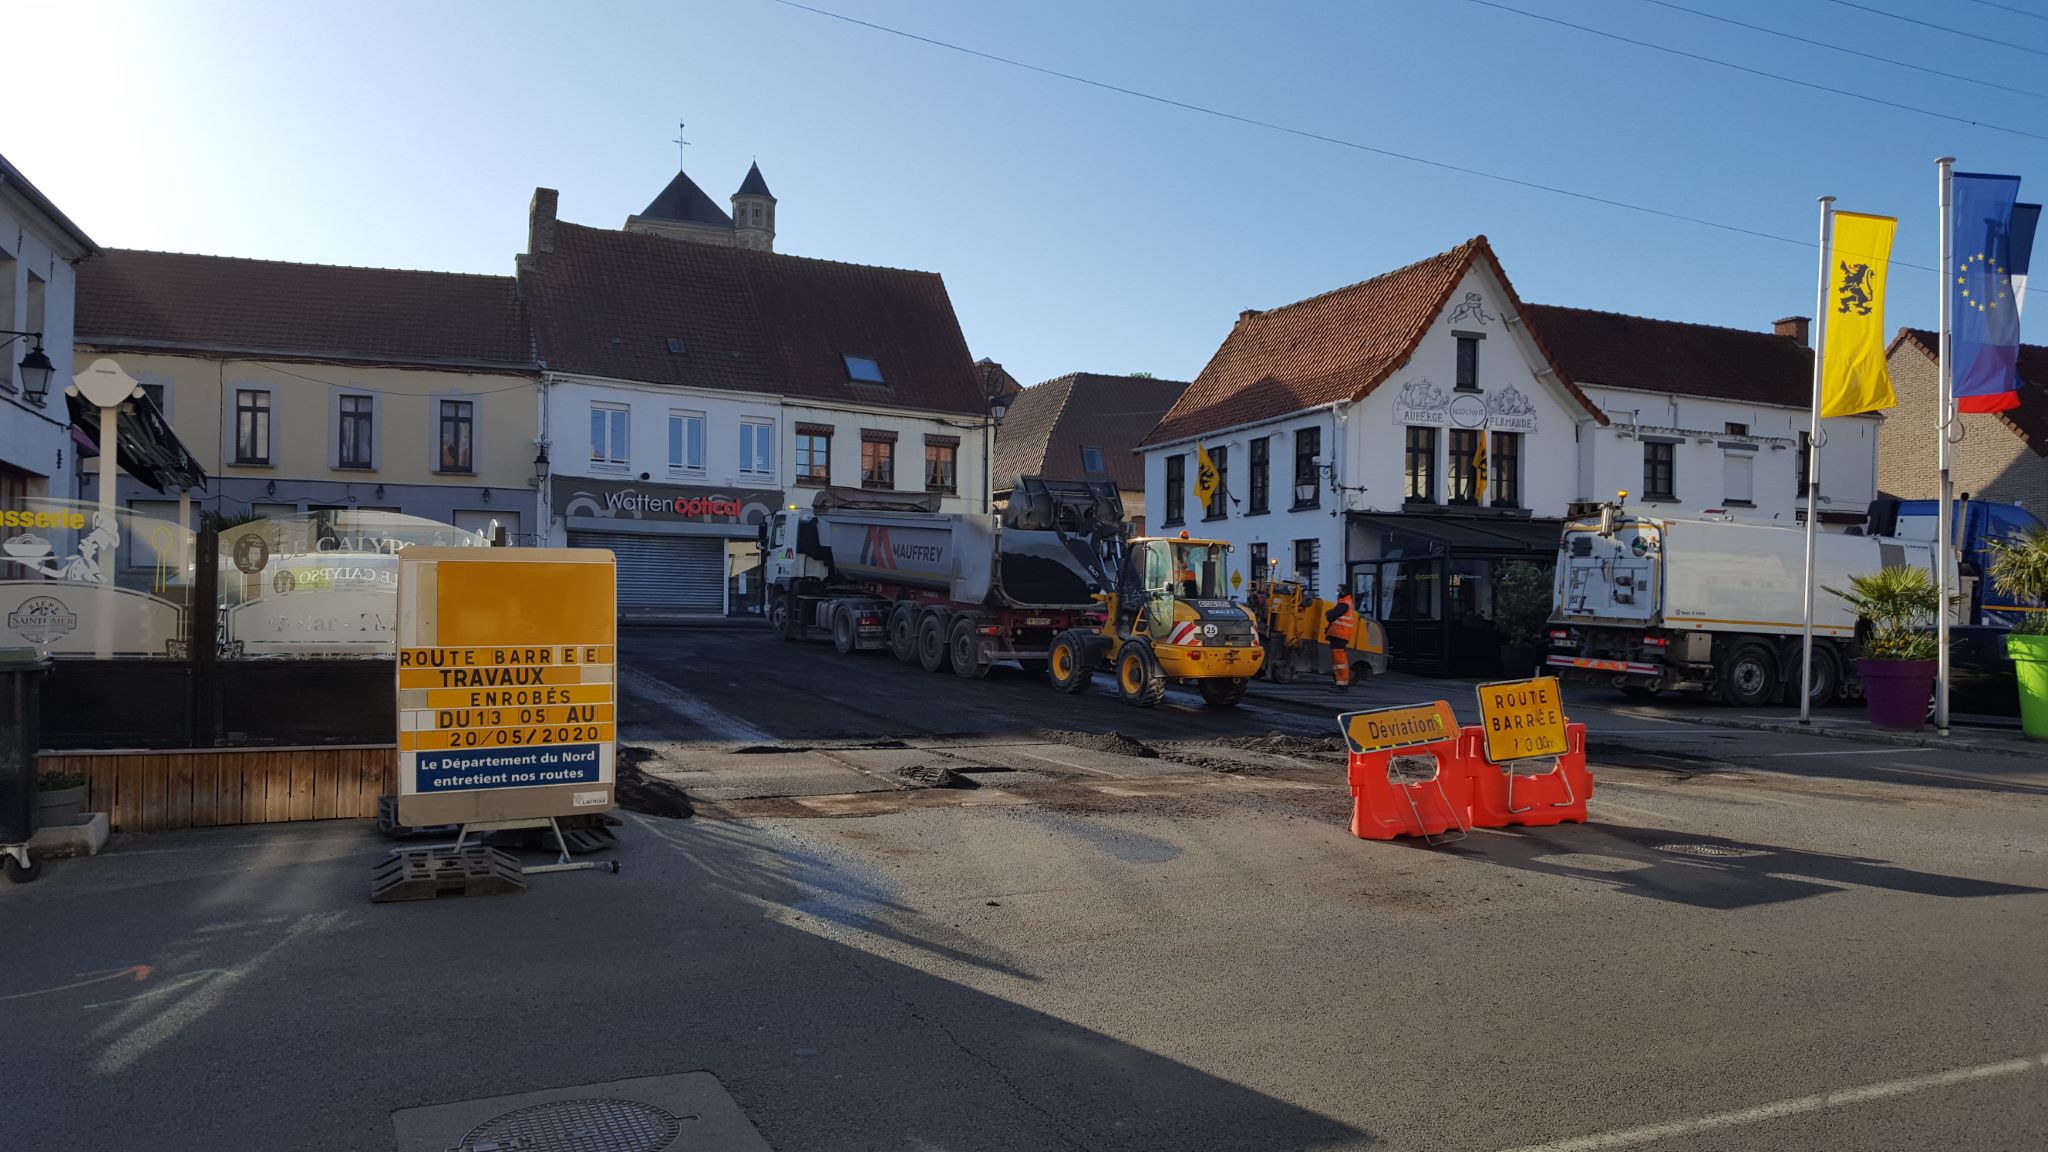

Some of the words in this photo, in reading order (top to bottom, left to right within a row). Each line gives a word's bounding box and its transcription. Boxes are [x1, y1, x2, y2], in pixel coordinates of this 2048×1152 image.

[1404, 411, 1444, 423] AUBERGE
[1490, 416, 1533, 428] FLAMANDE
[893, 543, 943, 562] MAUFFREY
[1205, 626, 1216, 634] 25
[400, 649, 476, 667] ROUTE
[439, 666, 545, 688] TRAVAUX
[470, 687, 571, 707] ENROBÉS
[1494, 689, 1547, 709] ROUTE
[520, 708, 546, 724] 05
[566, 705, 595, 723] AU
[1492, 708, 1557, 731] BARRÉE
[450, 726, 598, 747] 20/05/2020
[1368, 716, 1435, 740] Déviation
[421, 759, 437, 770] Le
[441, 754, 537, 770] Département
[540, 752, 558, 764] du
[562, 750, 595, 763] Nord
[433, 772, 507, 787] entretient
[511, 772, 536, 783] nos
[539, 769, 584, 781] routes
